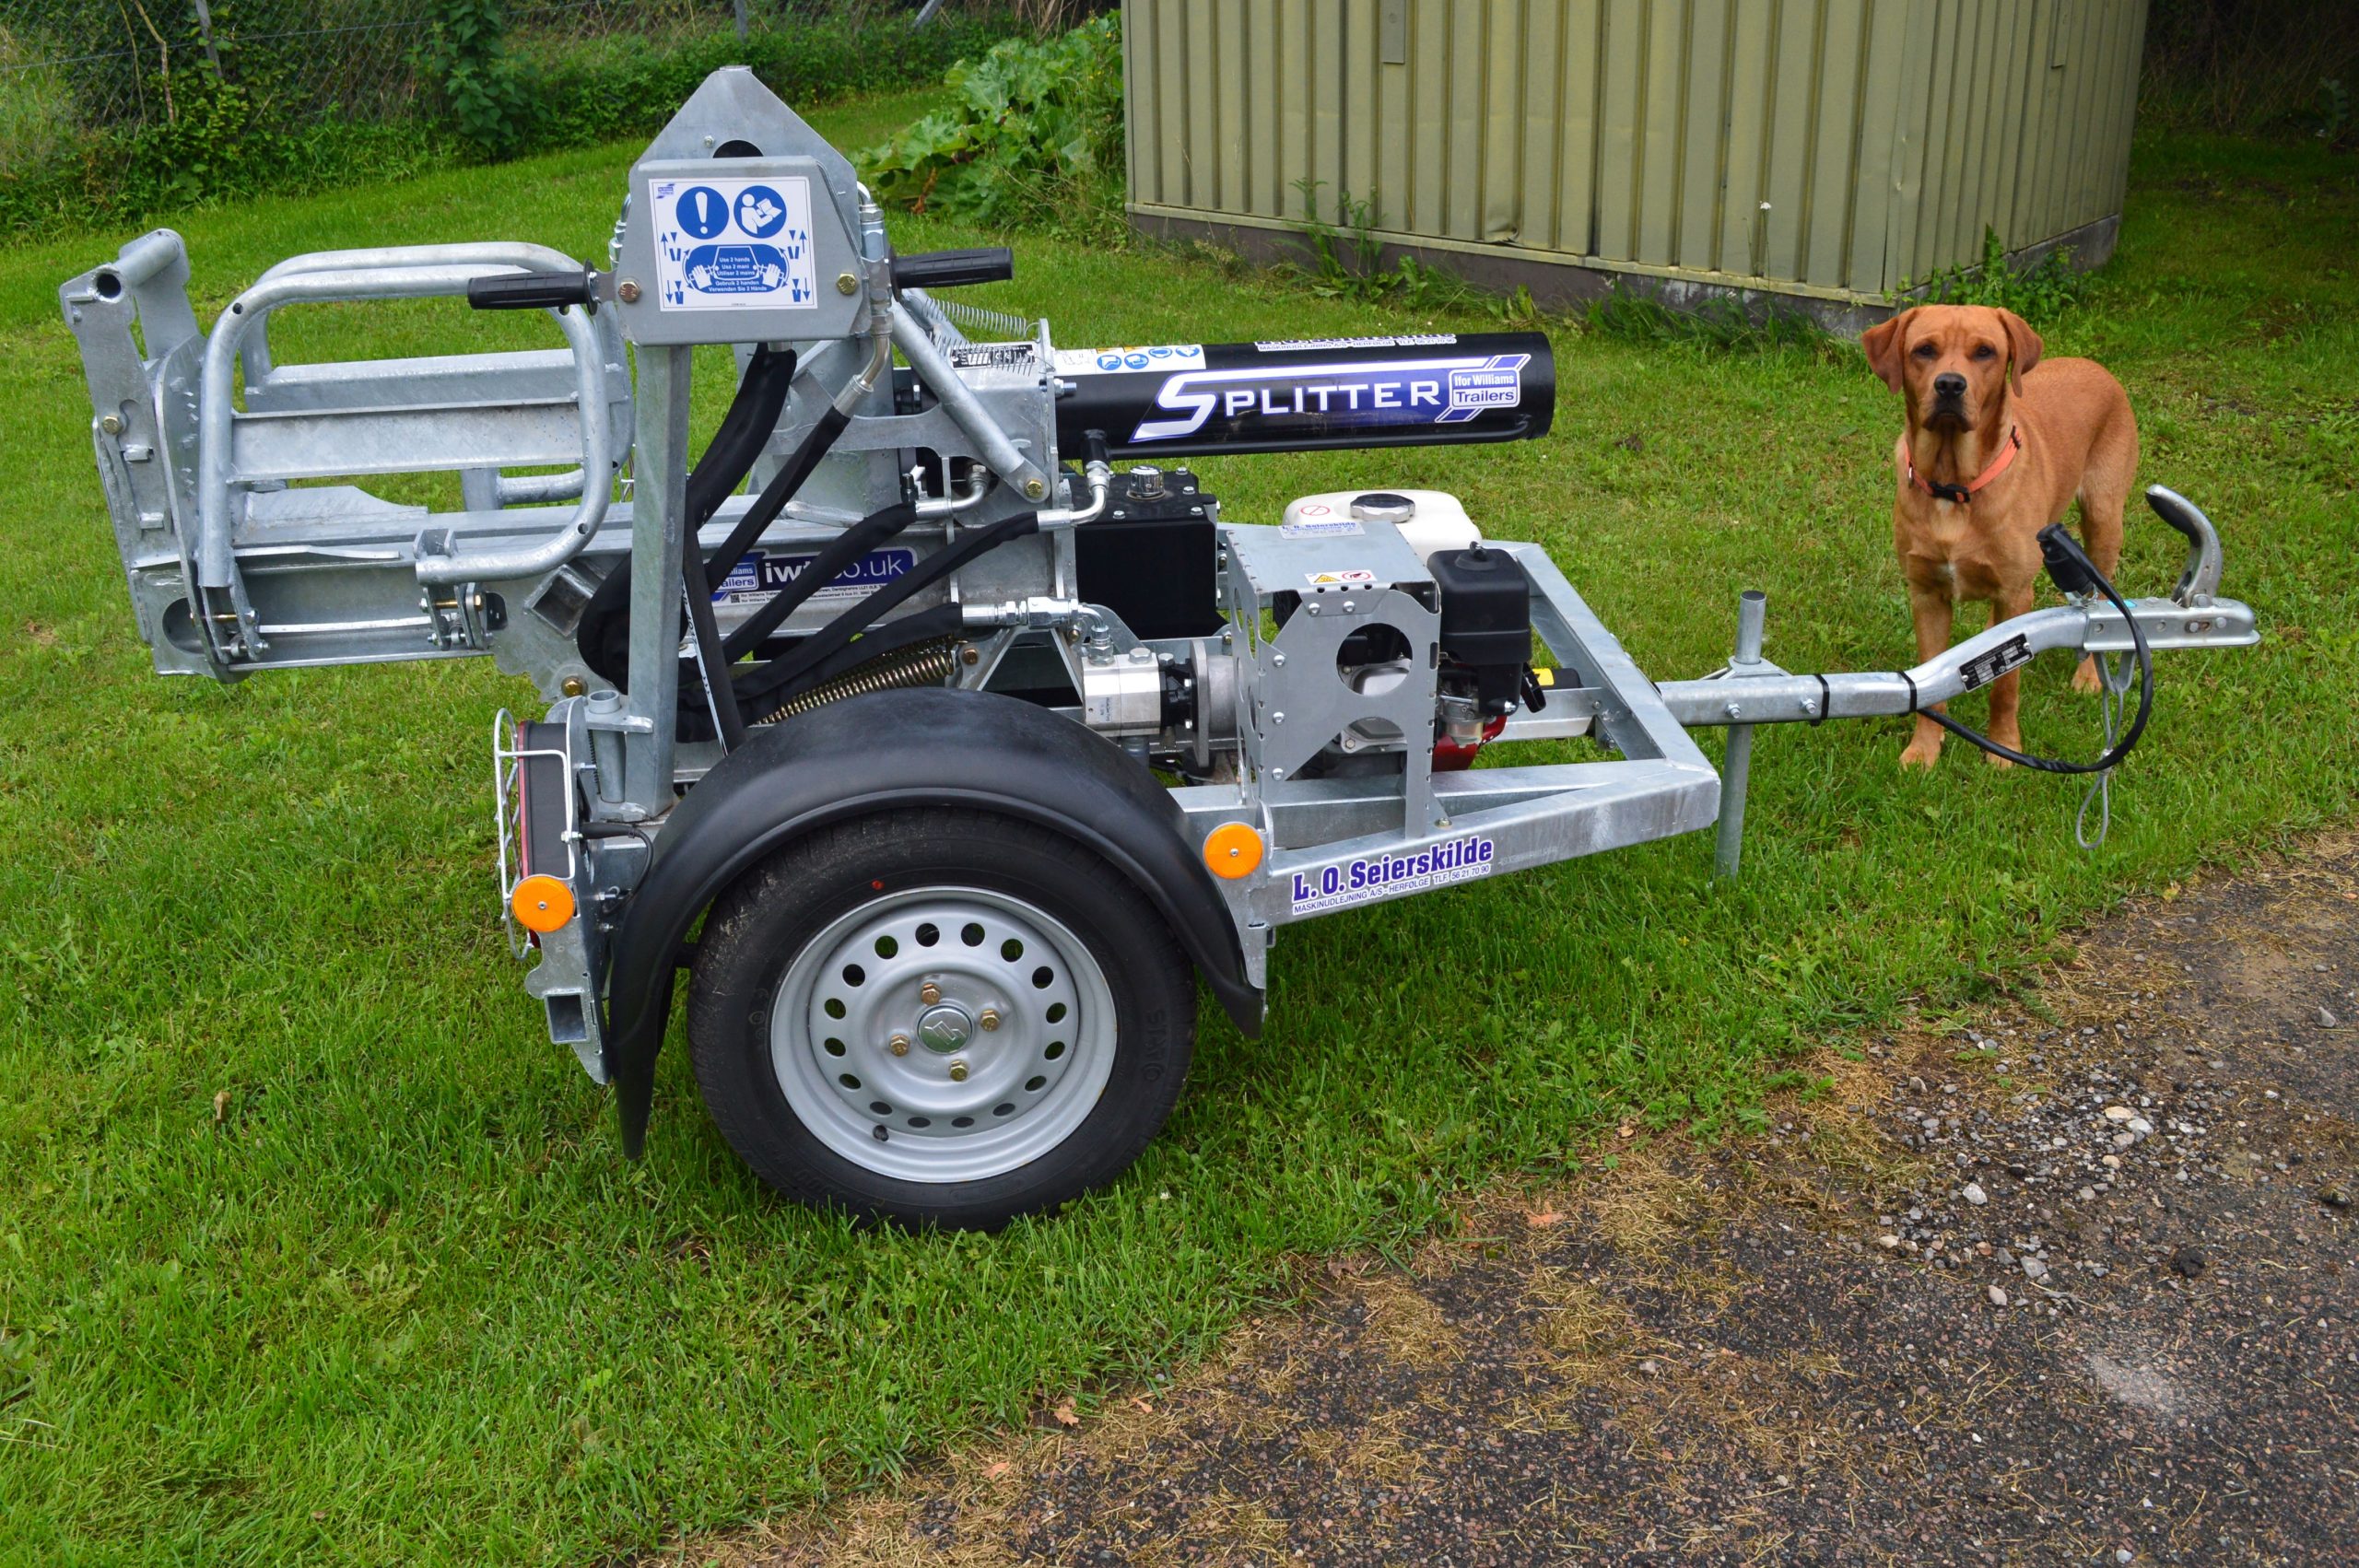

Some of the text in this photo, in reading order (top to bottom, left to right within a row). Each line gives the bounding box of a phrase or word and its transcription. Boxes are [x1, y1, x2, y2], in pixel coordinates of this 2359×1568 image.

[1130, 361, 1443, 442] SPLITTER
[1454, 374, 1516, 387] Ifor Williams
[1455, 389, 1515, 404] Trailers
[1293, 874, 1317, 902] L.
[1322, 866, 1345, 895] O.
[1350, 837, 1493, 890] Seierskilde
[1294, 891, 1367, 914] MASKINUDLEJNING
[1369, 888, 1383, 899] A/S
[1389, 877, 1430, 894] HERFØLGE
[1433, 873, 1449, 884] TLF.
[1451, 870, 1461, 881] 56
[1461, 869, 1470, 879] 21
[1471, 867, 1480, 877] 70
[1480, 864, 1490, 875] 90
